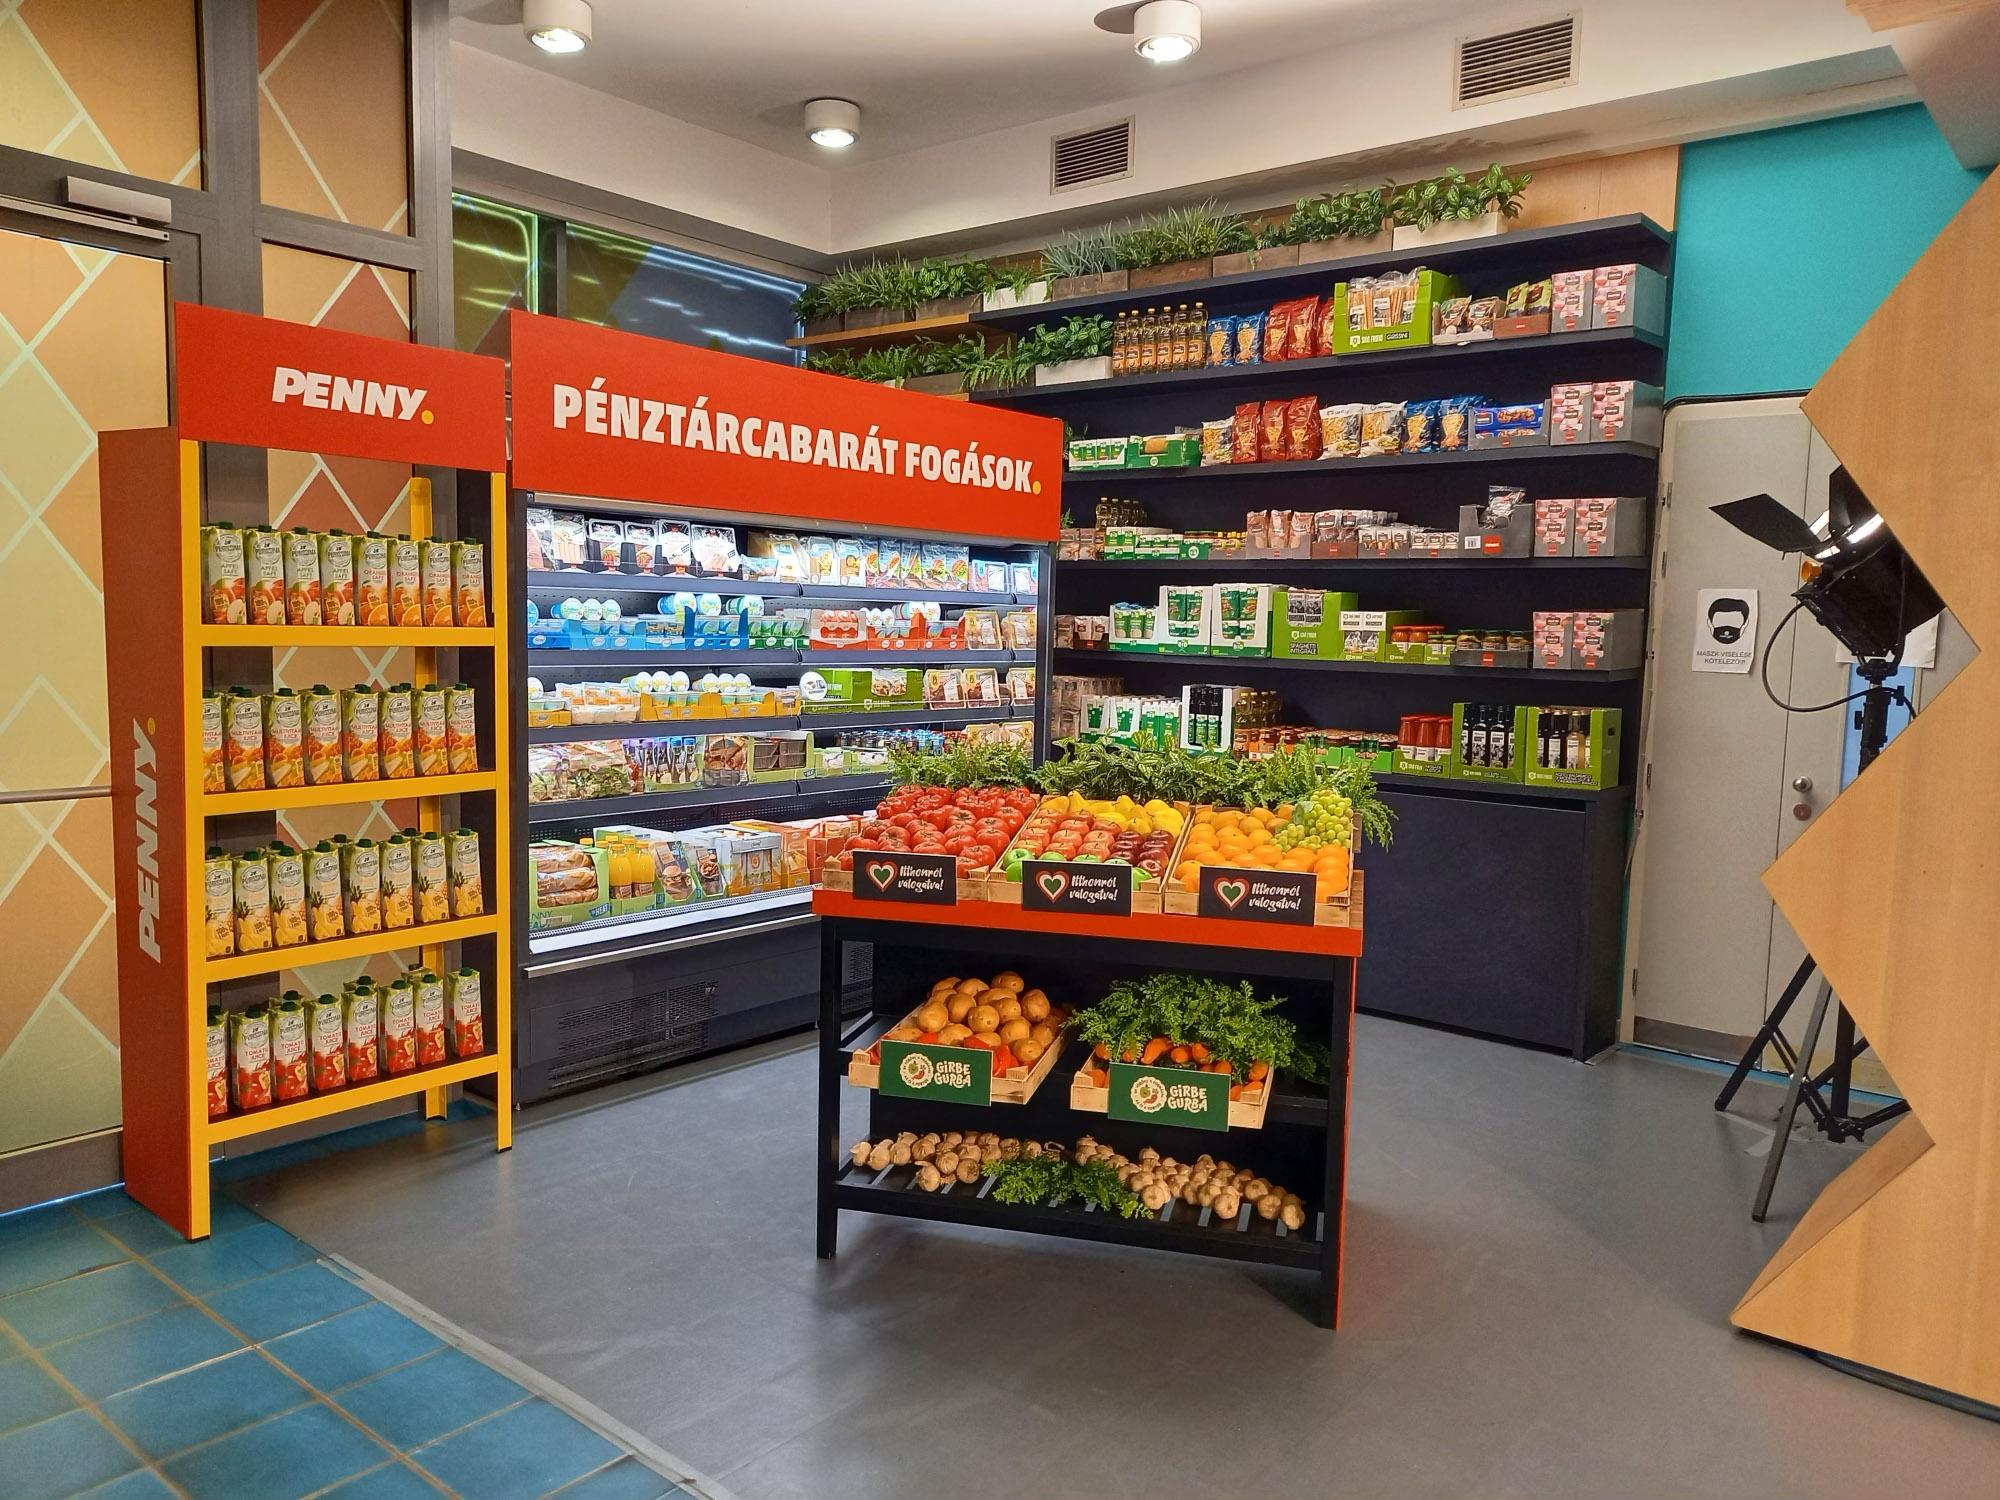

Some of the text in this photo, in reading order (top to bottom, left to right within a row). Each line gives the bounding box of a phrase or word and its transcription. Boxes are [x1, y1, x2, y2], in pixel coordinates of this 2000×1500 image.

[271, 366, 434, 425] PENNY.
[553, 376, 1042, 496] PÉNZTÁRCABARÁT FOGÁSOK.
[133, 717, 161, 964] PENNY.
[899, 865, 943, 878] Itthonról
[897, 878, 944, 892] válogatva!
[1071, 874, 1117, 888] Itthonról
[1069, 888, 1118, 904] válogatva!
[1251, 882, 1301, 897] Itthonról
[1249, 897, 1301, 912] válogatva!
[934, 1073, 971, 1089] GURBA
[1167, 1097, 1208, 1113] GURBA
